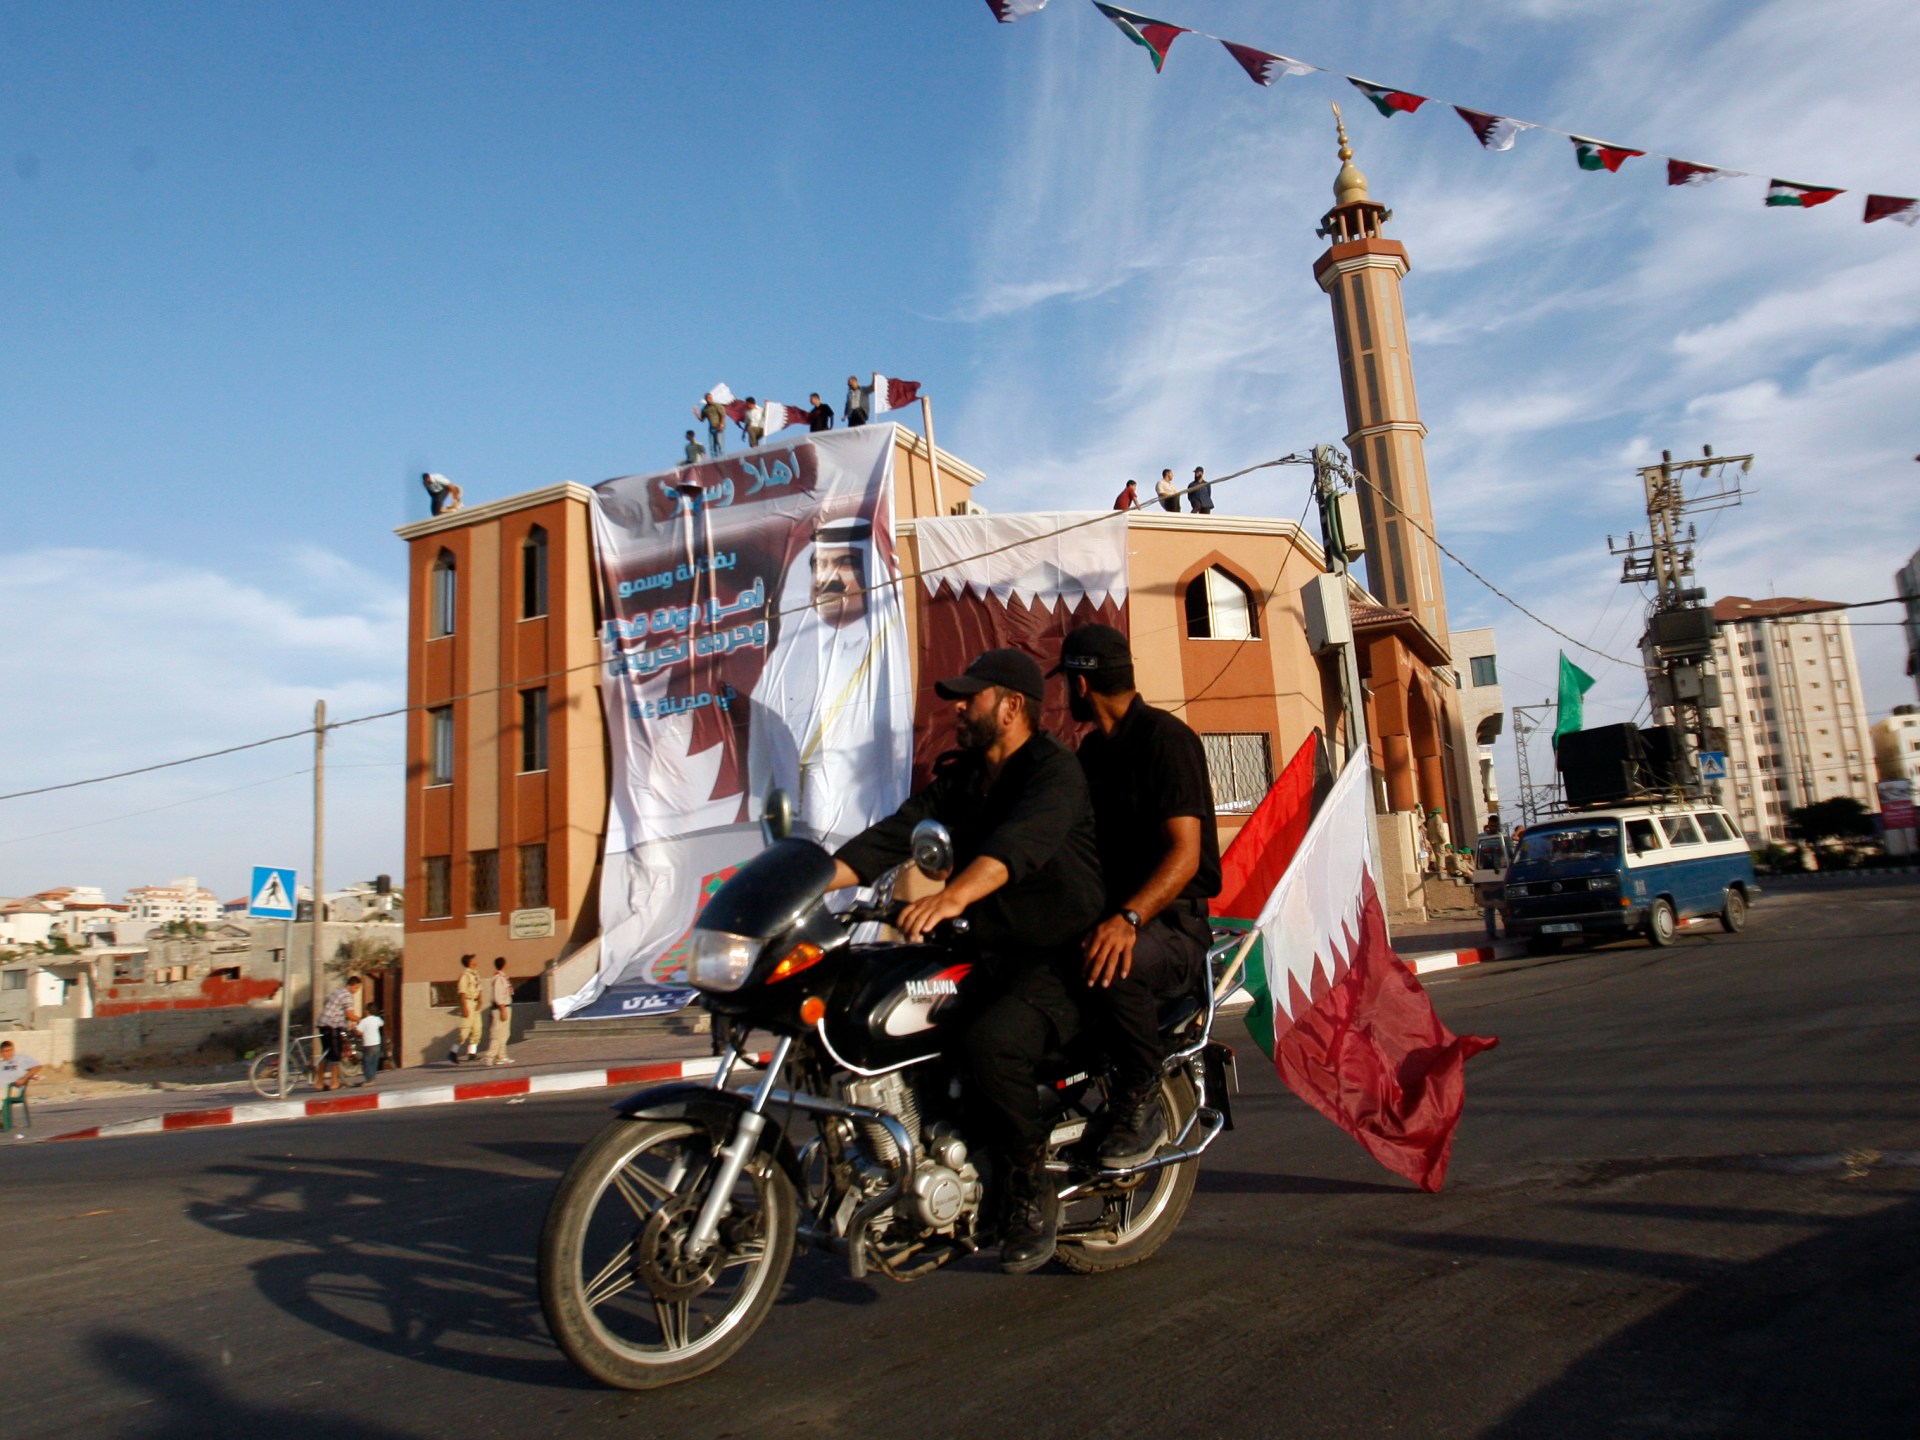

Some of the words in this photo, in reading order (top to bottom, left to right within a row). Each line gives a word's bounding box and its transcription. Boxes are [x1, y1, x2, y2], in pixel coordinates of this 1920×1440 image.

[618, 571, 673, 599] وسمو
[657, 692, 712, 716] مدينة
[905, 979, 958, 996] HALAWA
